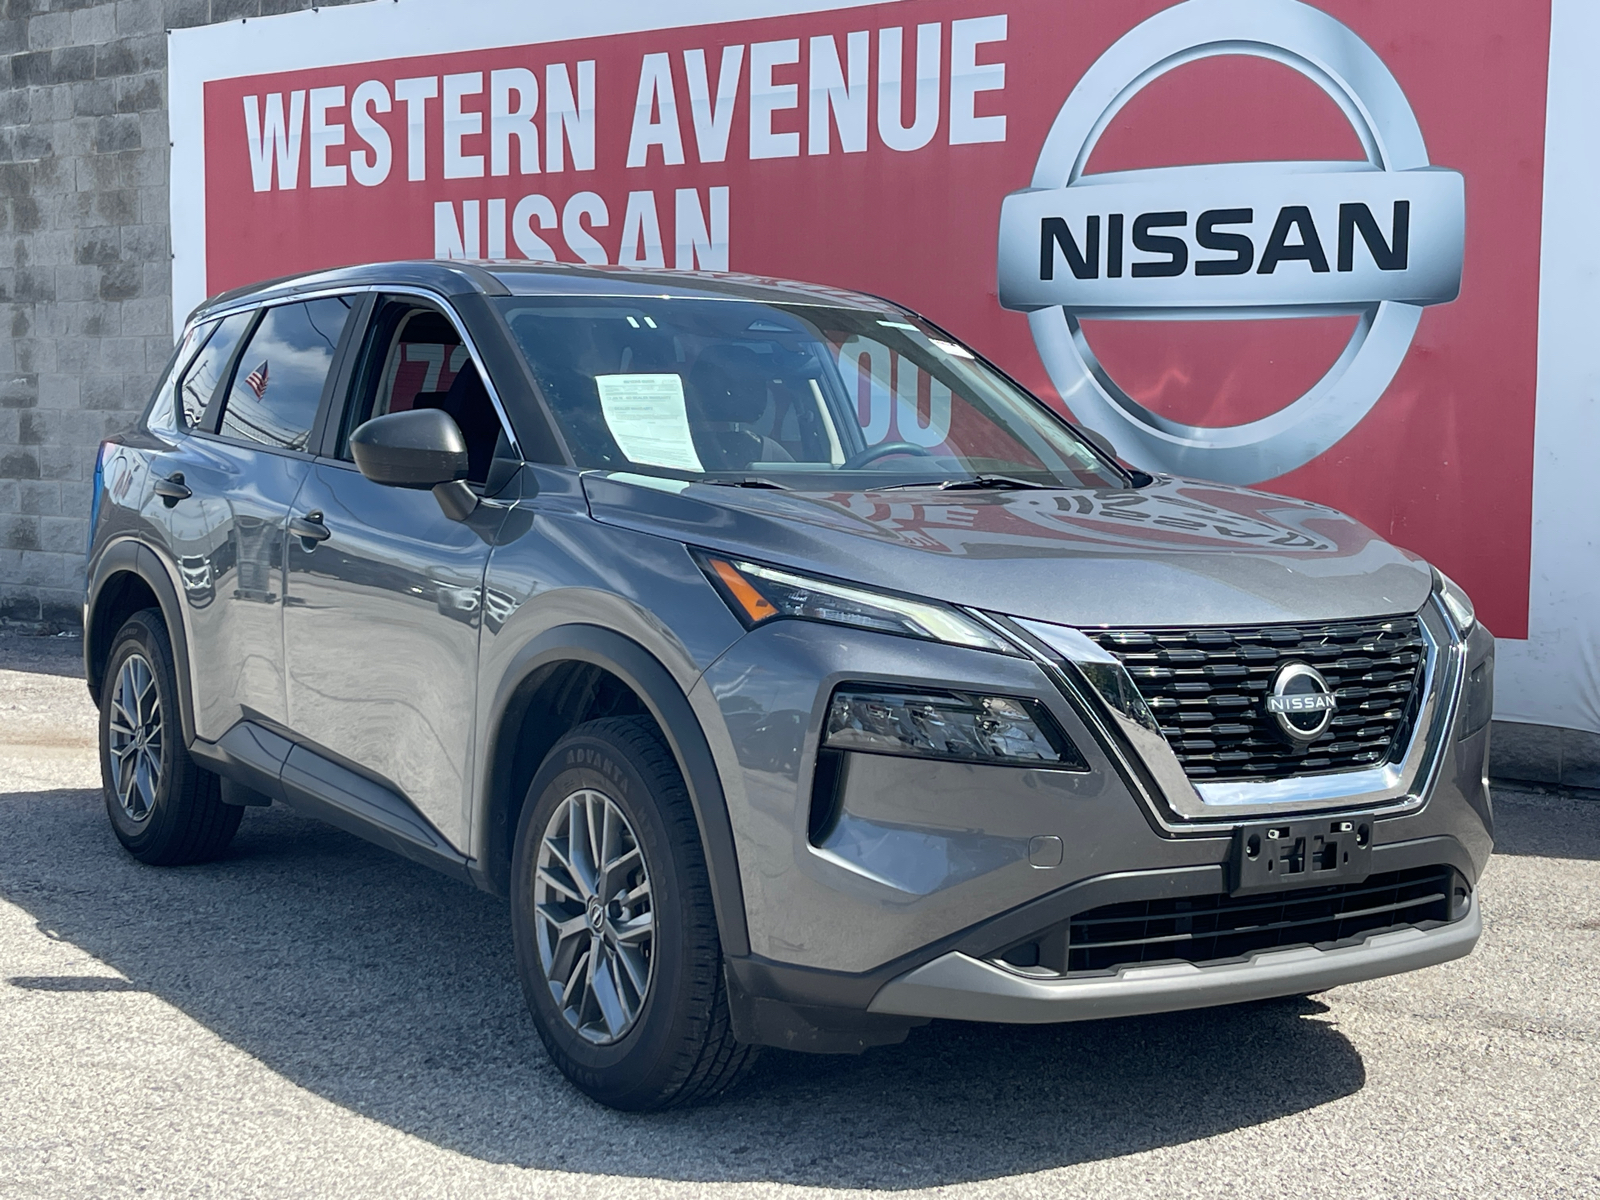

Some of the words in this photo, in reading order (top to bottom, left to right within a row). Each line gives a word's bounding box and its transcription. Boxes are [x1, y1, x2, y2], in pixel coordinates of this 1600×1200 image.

[243, 59, 597, 193] WESTERN
[626, 14, 1009, 169] AVENUE
[434, 186, 730, 273] NISSAN
[1040, 200, 1410, 281] NISSAN
[1271, 695, 1335, 710] NISSAN
